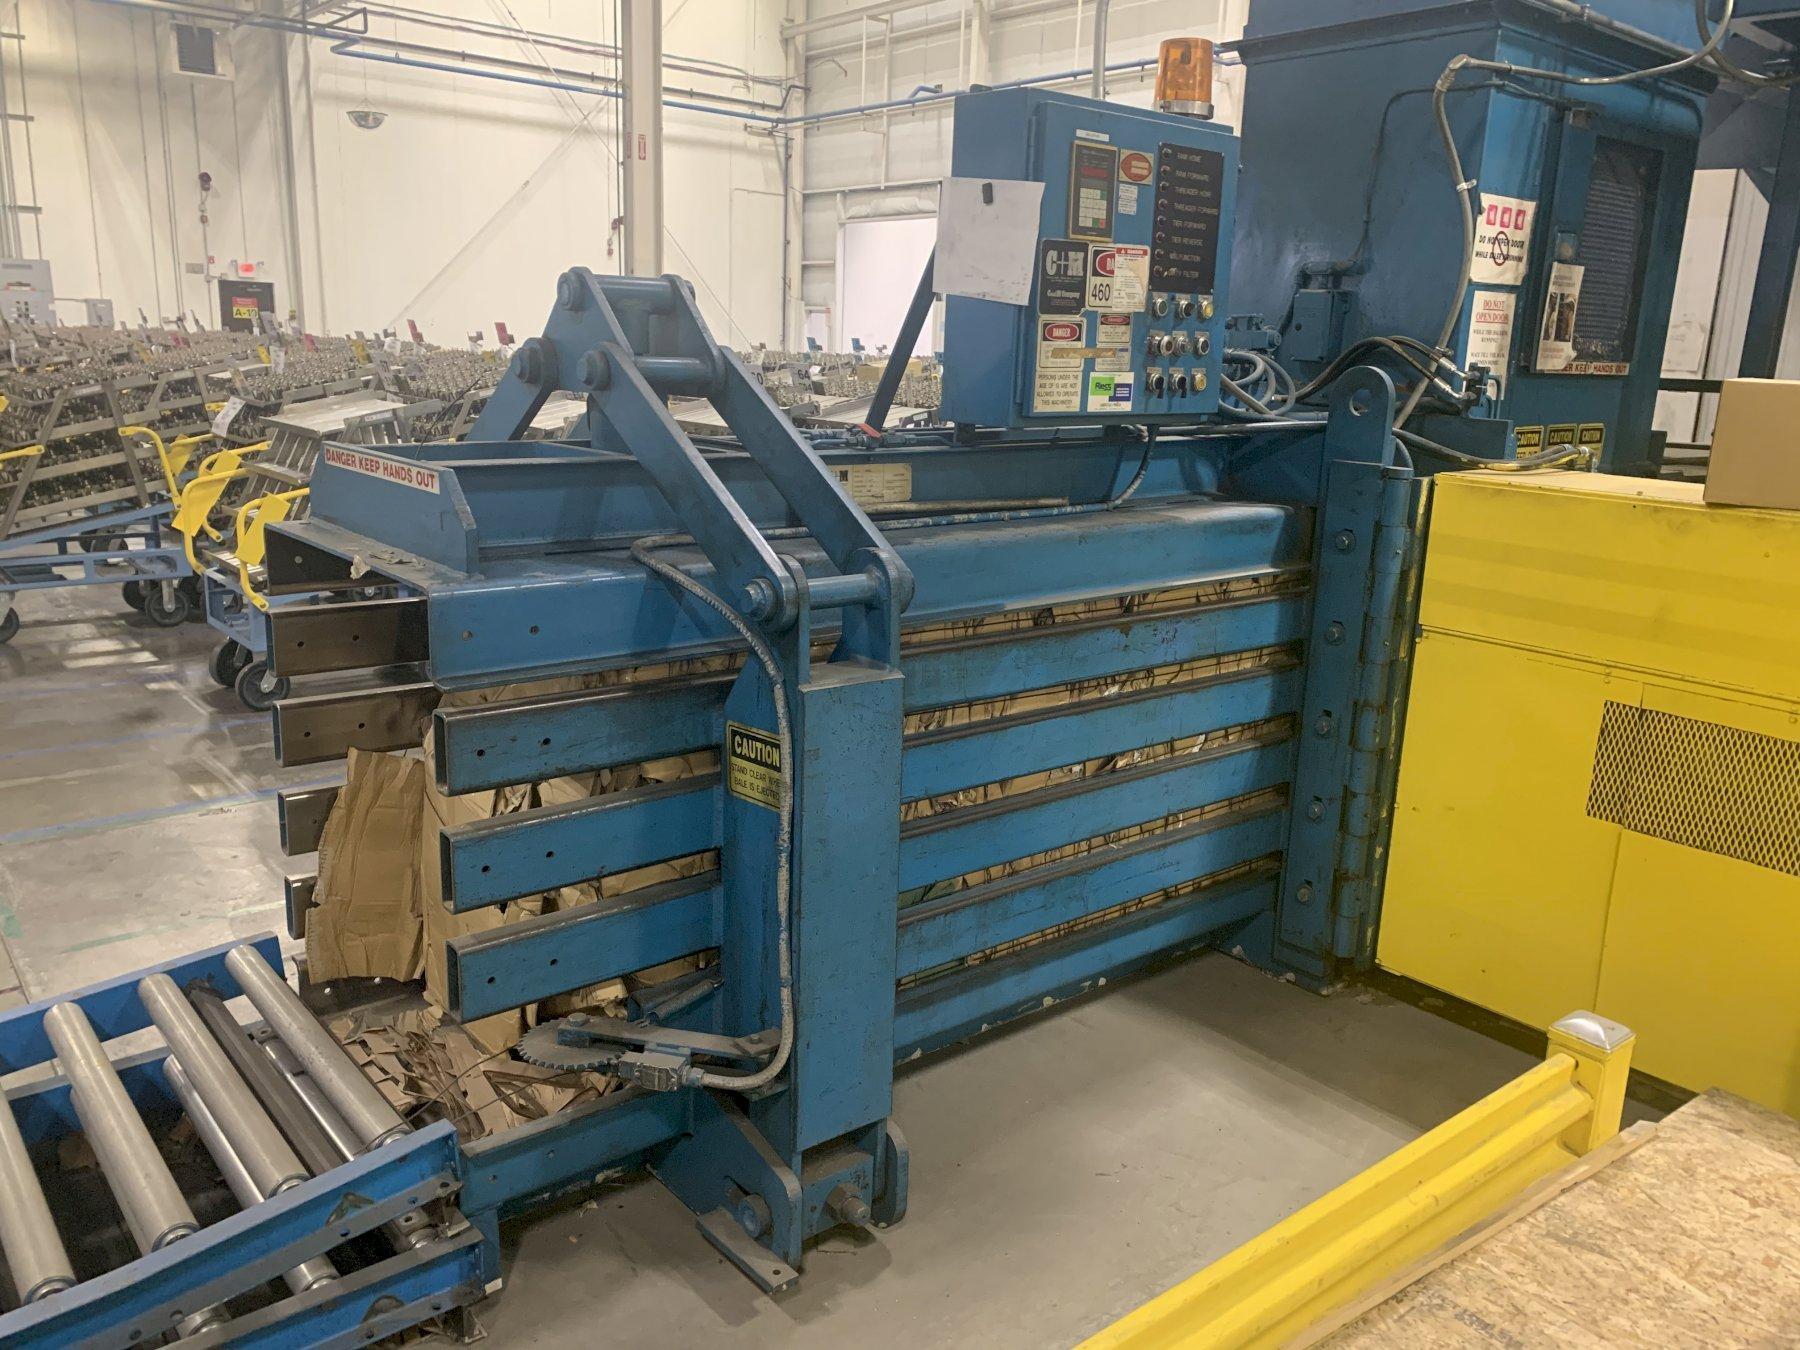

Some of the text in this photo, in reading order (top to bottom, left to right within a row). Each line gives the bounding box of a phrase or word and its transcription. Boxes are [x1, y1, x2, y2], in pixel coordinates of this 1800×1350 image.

[1479, 235, 1486, 244] DO
[1511, 240, 1524, 249] DOOR
[1475, 251, 1488, 259] WHILE
[1091, 283, 1111, 301] 460
[1483, 300, 1505, 309] DO NOT
[1475, 312, 1509, 322] OPEN DOOR
[1053, 328, 1071, 337] DANGER
[1593, 364, 1614, 373] HANDS
[1615, 366, 1627, 374] OUT
[1550, 430, 1573, 443] CAUTION
[1582, 430, 1600, 442] CAUTION
[326, 448, 435, 489] DANGER KEEP HANDS OUT
[734, 734, 780, 767] CAUTION
[731, 763, 748, 775] STAND
[750, 769, 767, 781] CLEAR
[734, 777, 747, 789] BALE
[750, 782, 755, 791] IS
